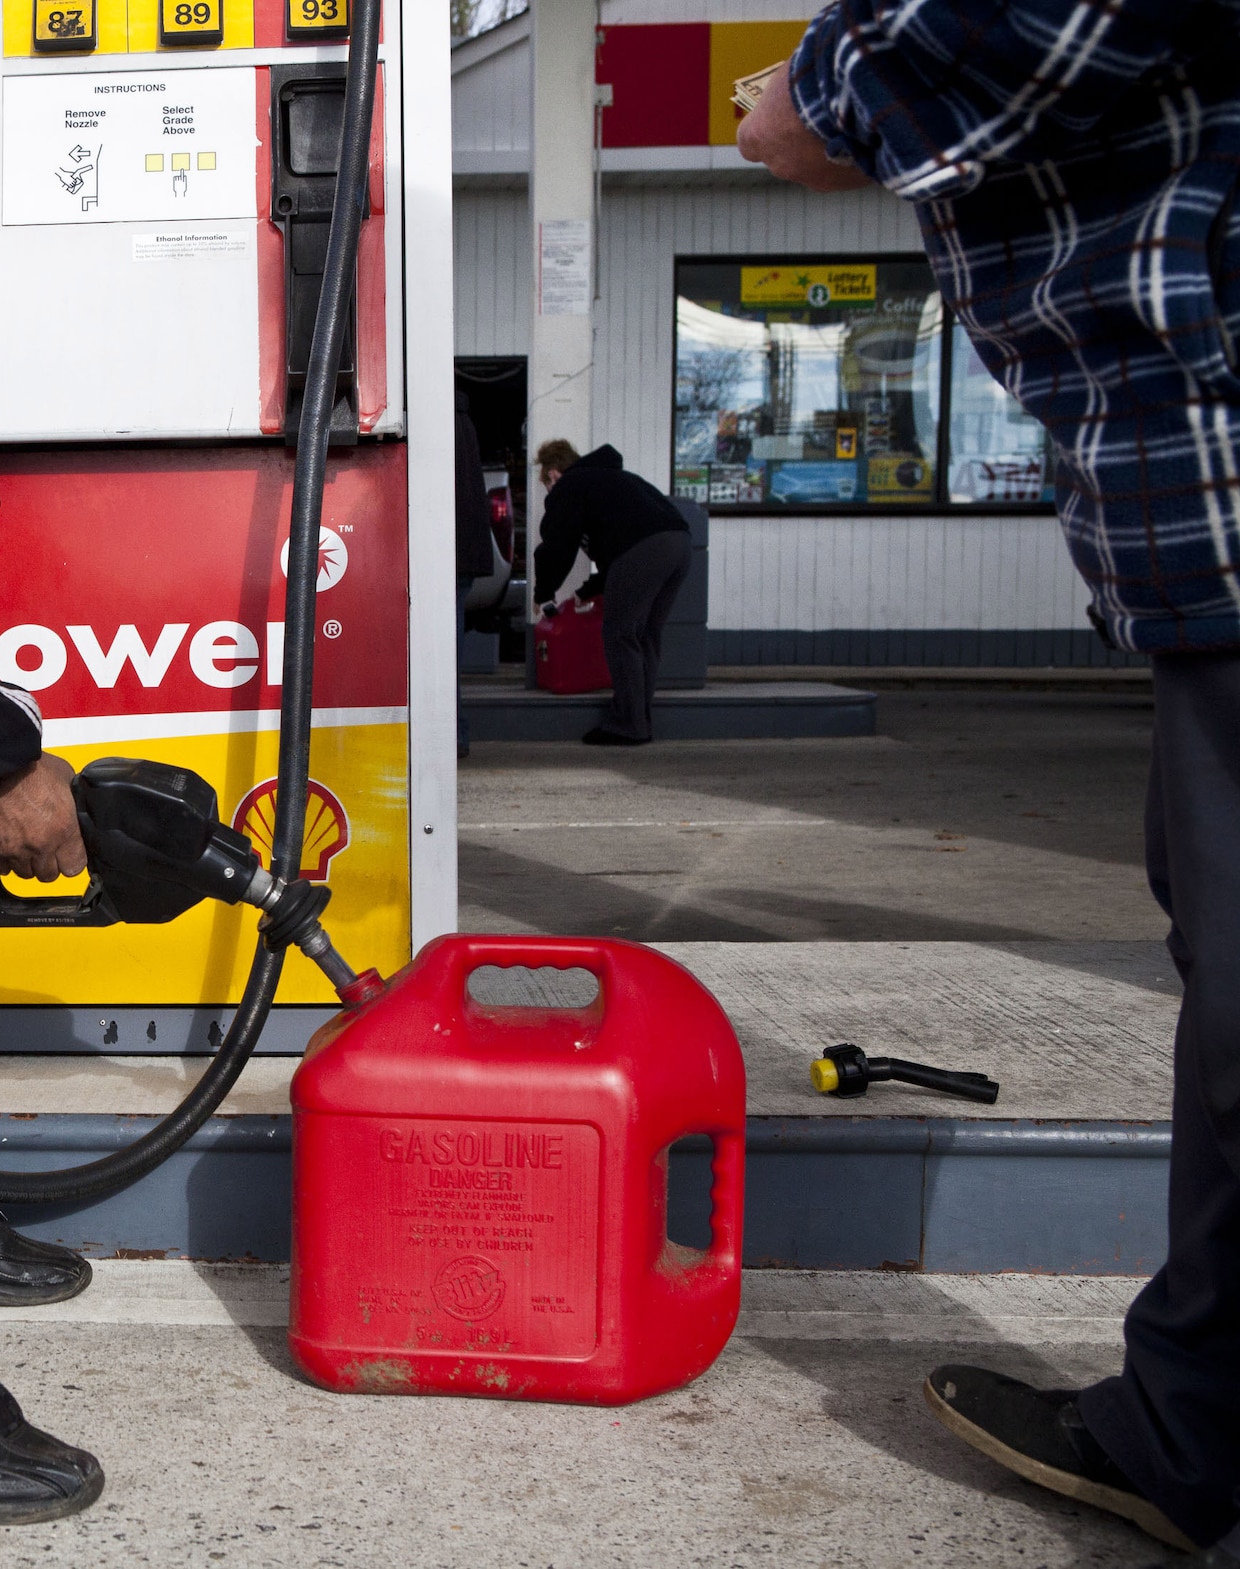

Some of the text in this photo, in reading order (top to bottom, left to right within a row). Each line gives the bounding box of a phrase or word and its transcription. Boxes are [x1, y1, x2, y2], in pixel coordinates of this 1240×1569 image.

[175, 3, 210, 25] 89
[302, 0, 338, 20] 93
[48, 10, 83, 36] 87
[94, 83, 166, 94] INSTRUCTIONS
[65, 110, 106, 118] Remove
[162, 106, 194, 115] Select
[65, 119, 99, 128] Nozzle
[162, 116, 194, 125] Grade
[163, 127, 195, 135] Above
[185, 233, 228, 241] Information
[827, 272, 869, 285] Lottery
[835, 284, 872, 295] Tickets
[379, 1128, 563, 1169] GASOLINE
[429, 1168, 512, 1190] DANGER
[497, 1213, 555, 1224] SWALLOWED
[410, 1225, 533, 1238] KEEP OUT OF REACH
[408, 1237, 533, 1252] OR USE BY CHILDREN
